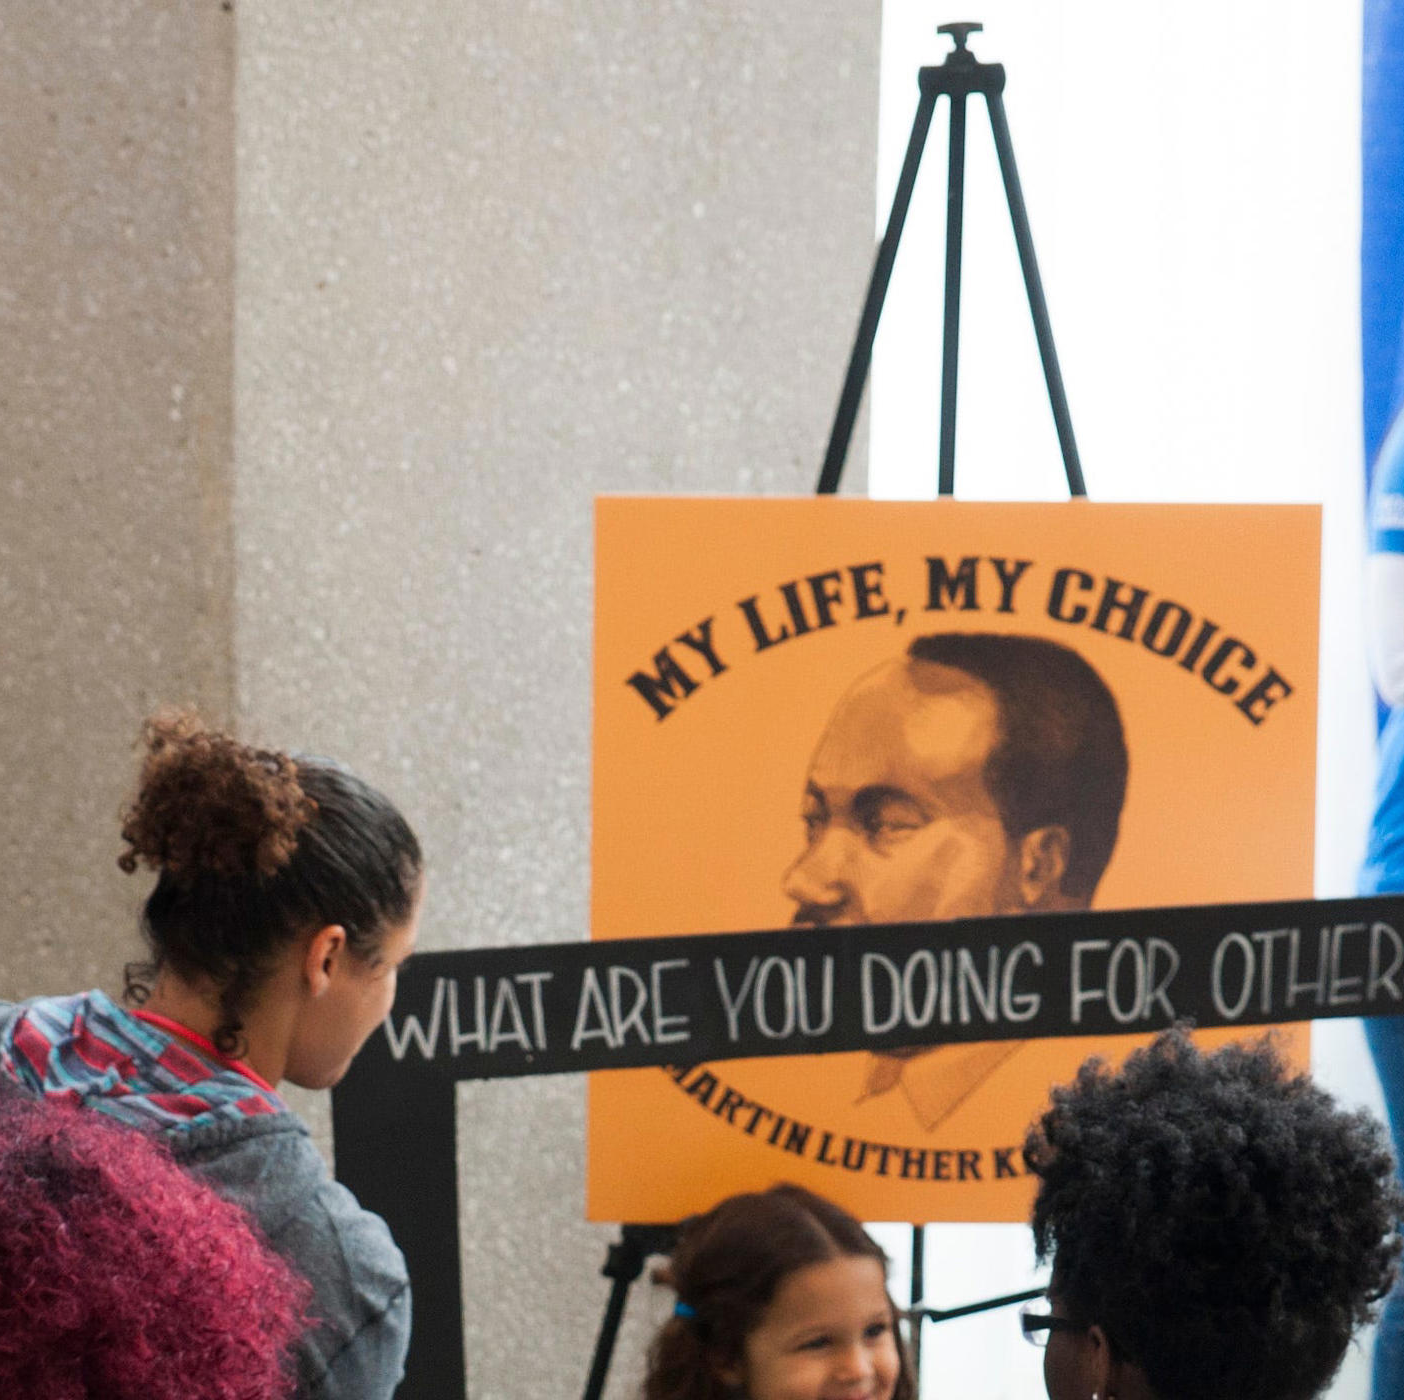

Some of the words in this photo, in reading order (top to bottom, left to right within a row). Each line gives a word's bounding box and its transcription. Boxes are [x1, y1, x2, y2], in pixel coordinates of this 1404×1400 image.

[625, 616, 729, 723] MY
[736, 561, 907, 653] LIFE,
[925, 556, 1034, 614] MY
[1047, 567, 1293, 726] CHOICE
[384, 971, 554, 1060] WHAT
[570, 958, 690, 1051] ARE
[714, 954, 835, 1042] YOU
[860, 941, 1044, 1035] DOING
[1070, 937, 1180, 1025] FOR
[815, 1130, 982, 1182] LUTHER
